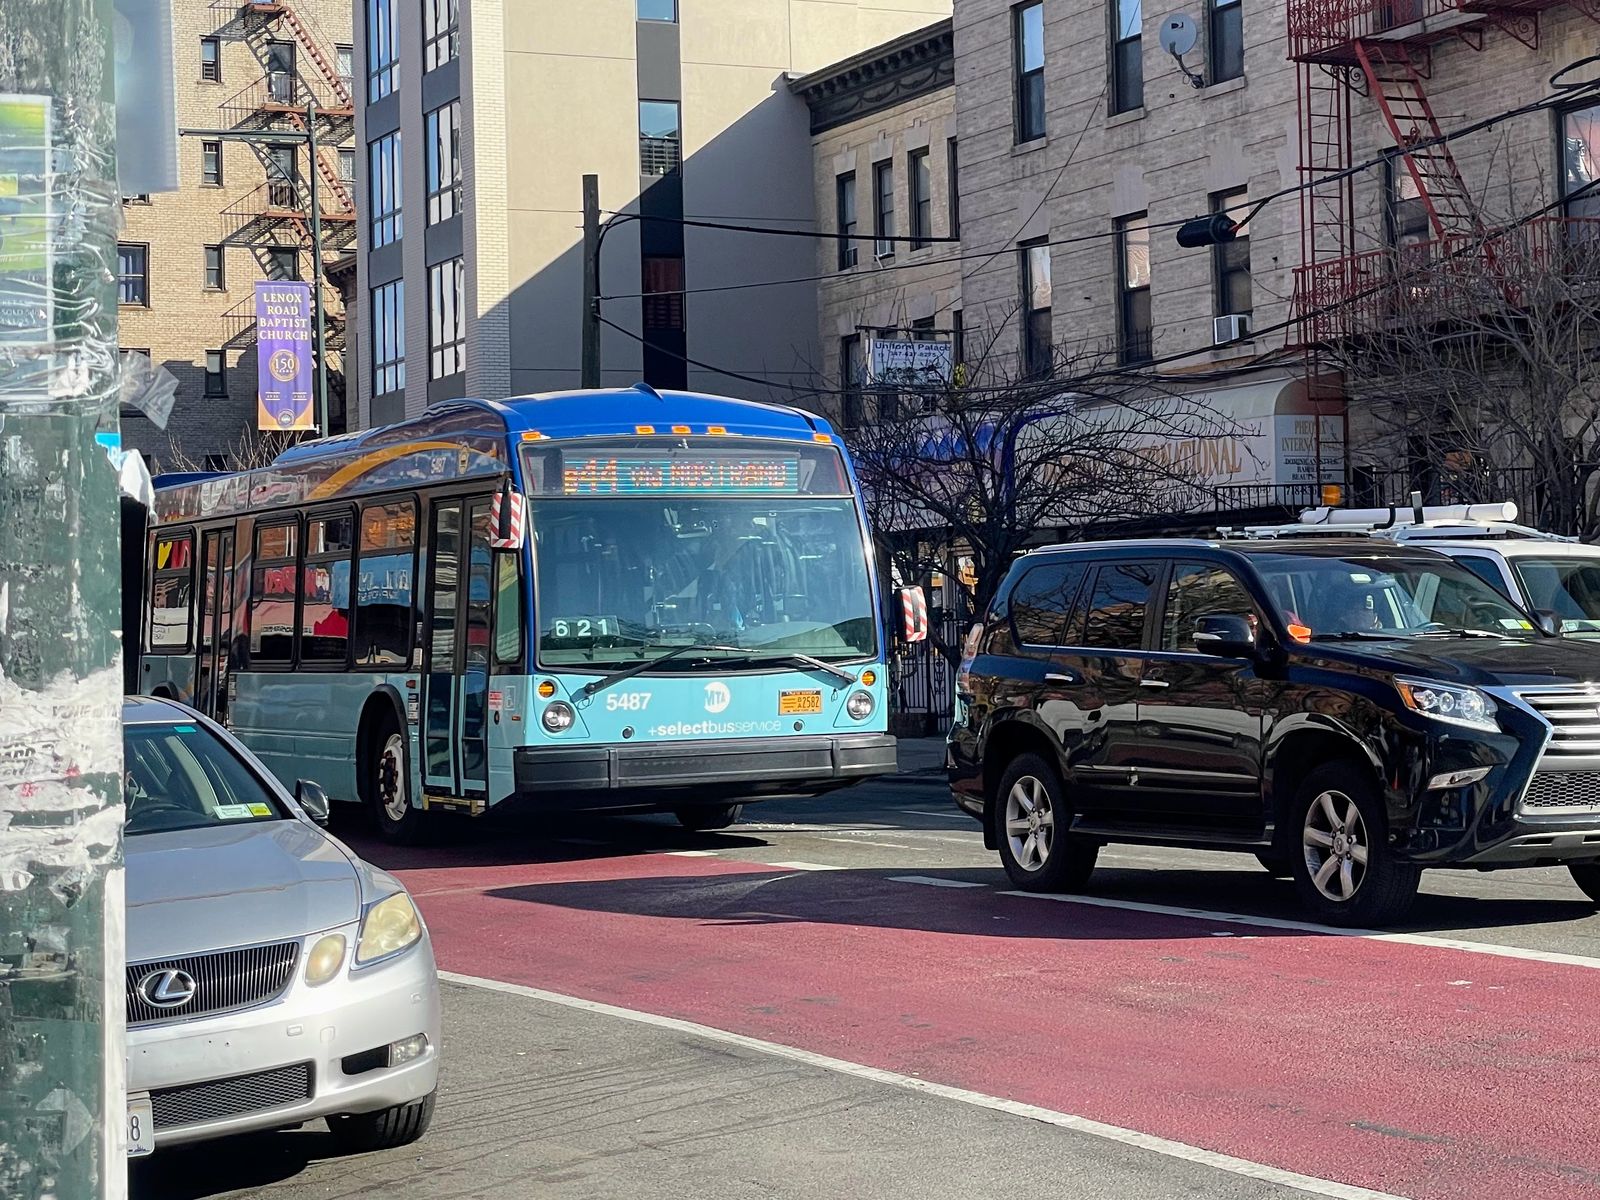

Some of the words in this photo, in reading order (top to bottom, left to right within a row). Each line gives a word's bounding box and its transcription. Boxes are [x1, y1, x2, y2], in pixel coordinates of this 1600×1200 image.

[263, 293, 302, 303] LENOX
[267, 306, 299, 315] ROAD
[260, 317, 307, 328] BAPTIST
[260, 330, 308, 341] CHURCH
[275, 358, 295, 369] 150
[606, 692, 652, 711] 5487
